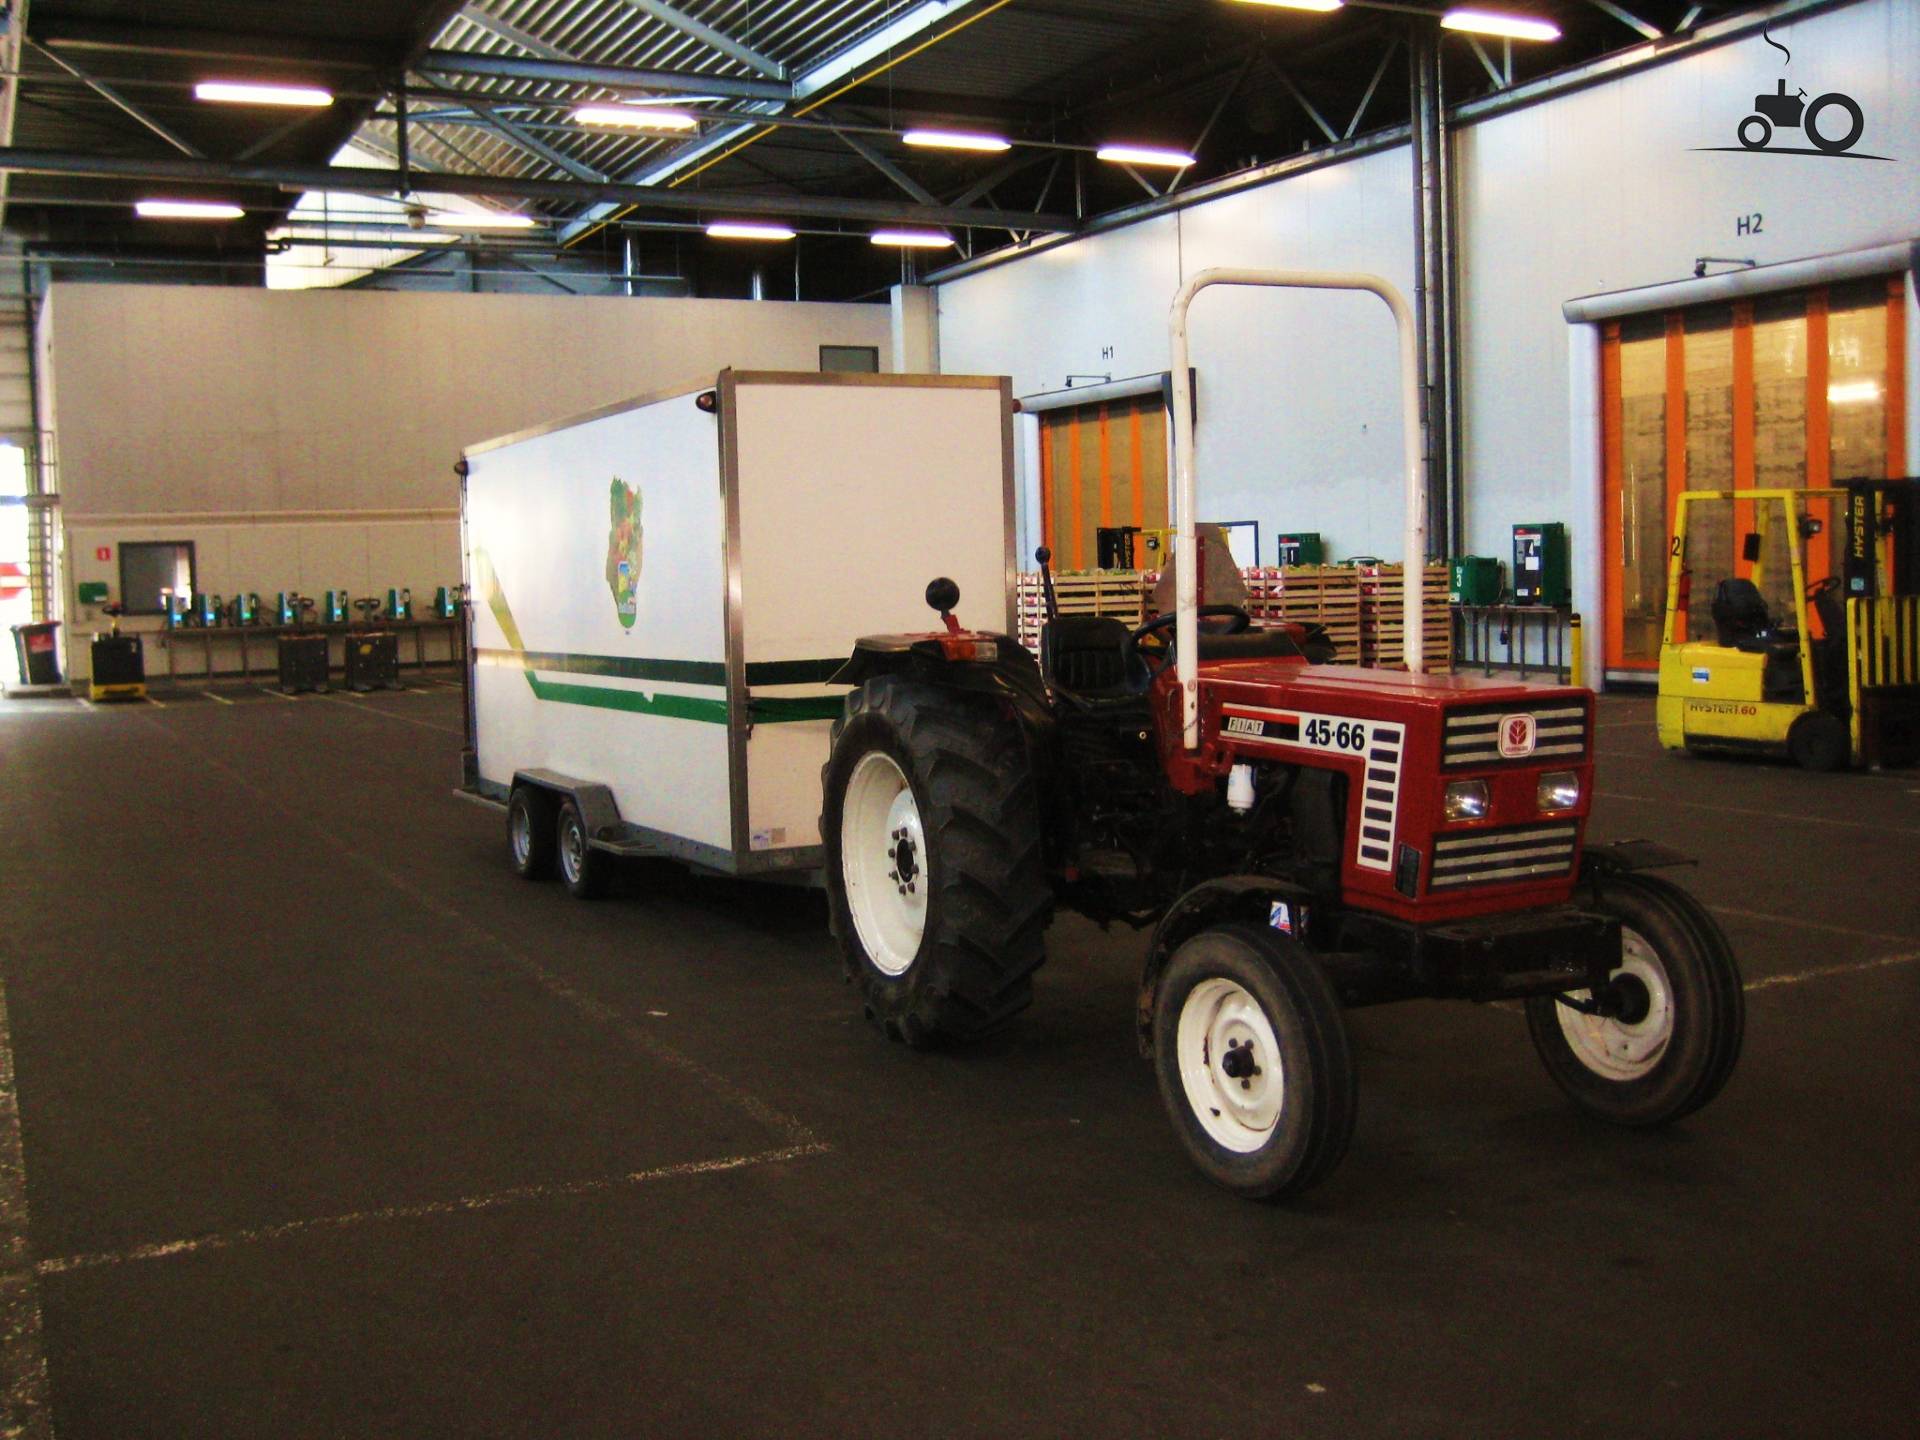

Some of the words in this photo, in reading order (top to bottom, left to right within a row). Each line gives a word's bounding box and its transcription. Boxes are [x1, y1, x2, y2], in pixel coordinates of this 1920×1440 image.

[1737, 212, 1763, 237] H2
[1102, 345, 1114, 361] H1
[1854, 495, 1864, 558] HYSTER
[1671, 535, 1681, 556] 2
[1229, 717, 1263, 734] FIAT
